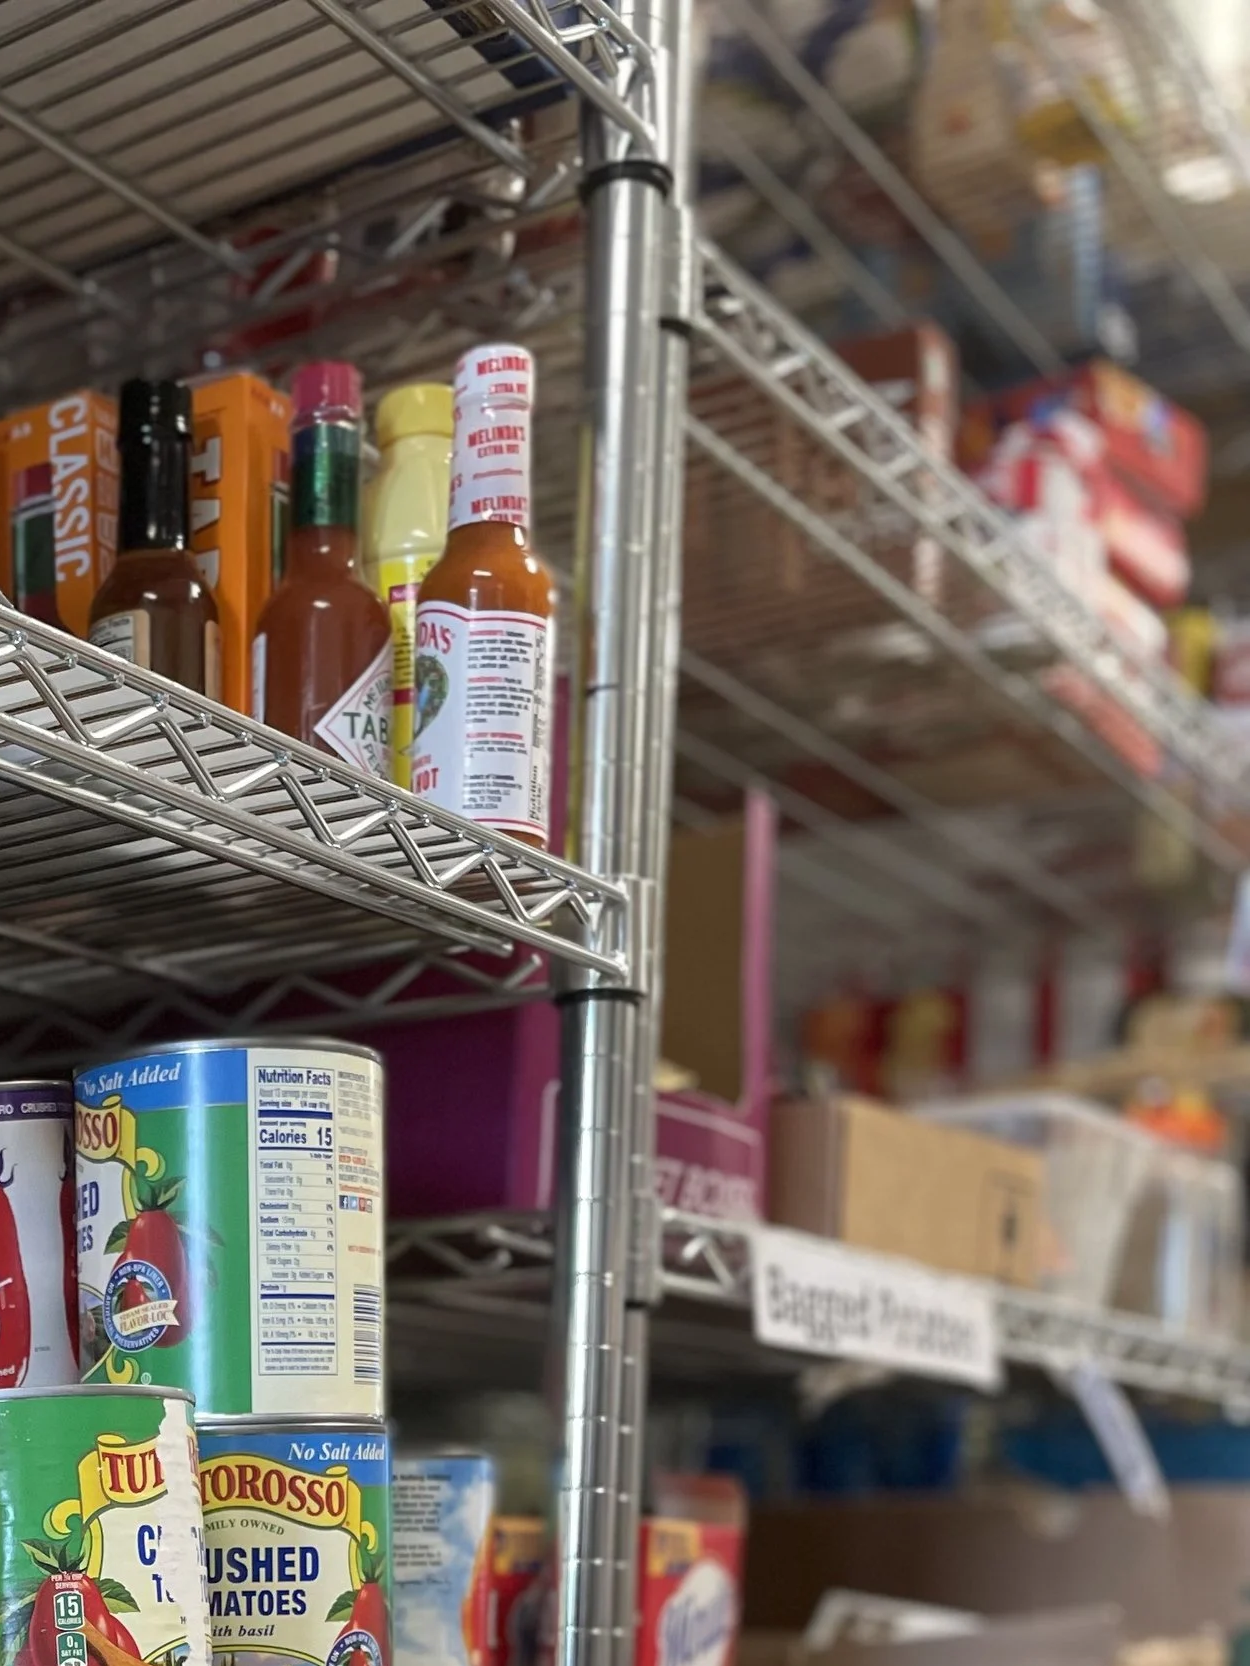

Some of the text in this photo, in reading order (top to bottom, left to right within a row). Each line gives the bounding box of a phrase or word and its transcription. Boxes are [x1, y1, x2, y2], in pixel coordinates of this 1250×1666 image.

[49, 396, 90, 582] CLASSIC
[83, 1063, 181, 1096] No Salt Added
[258, 1068, 331, 1086] Nutrition Facts
[259, 1127, 332, 1146] Calories 15
[287, 1442, 385, 1462] No Salt Added
[57, 1595, 79, 1617] 15
[238, 1624, 275, 1638] basil
